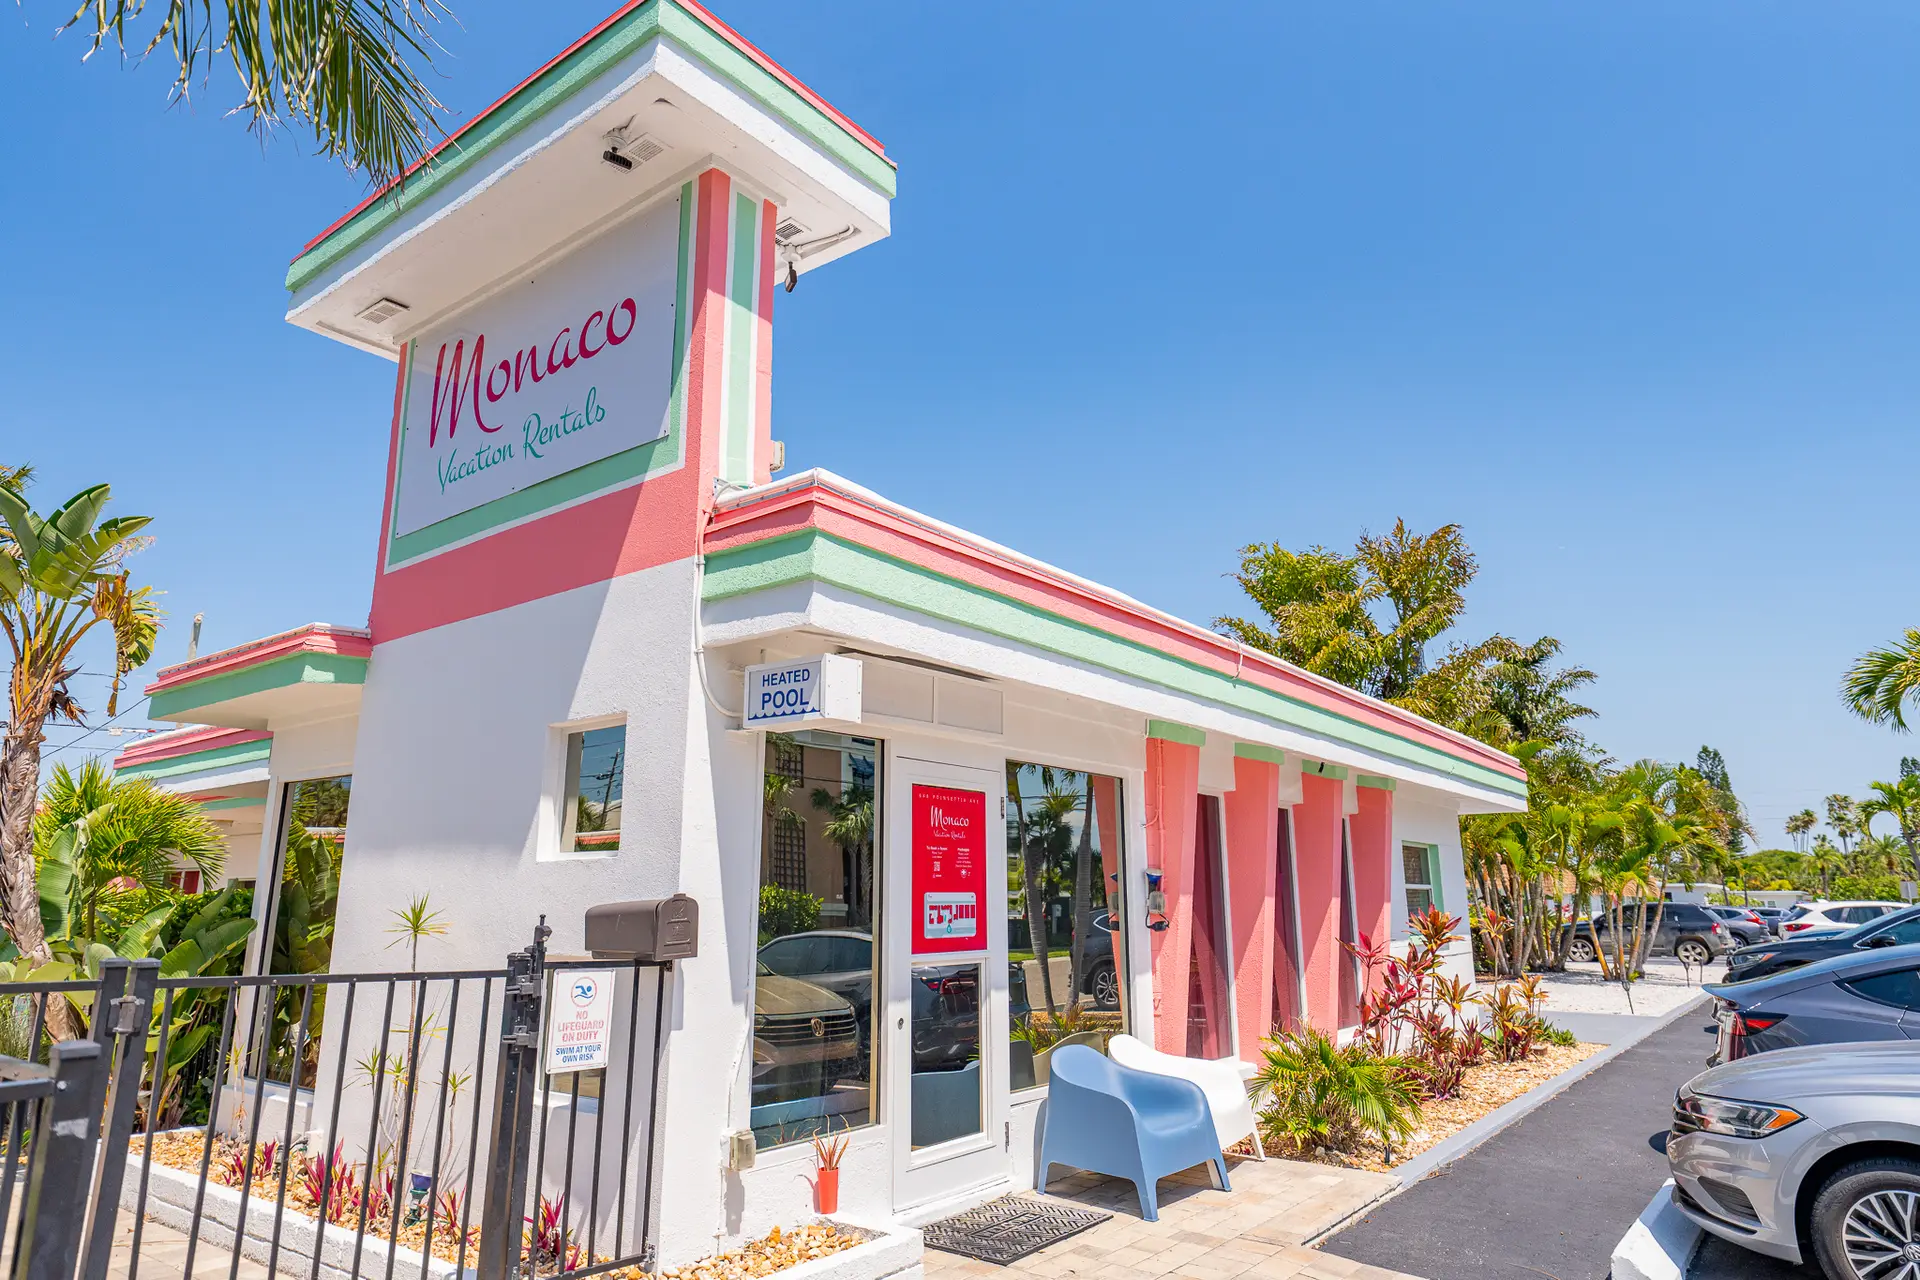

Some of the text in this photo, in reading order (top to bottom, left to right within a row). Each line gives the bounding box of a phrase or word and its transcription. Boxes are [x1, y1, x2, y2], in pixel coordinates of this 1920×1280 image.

[430, 298, 637, 449] Monaco
[438, 386, 606, 495] Vacation Rentals
[762, 668, 810, 687] HEATED
[761, 688, 809, 710] POOL
[930, 805, 969, 831] Monaco
[575, 1010, 589, 1020] NO
[557, 1020, 605, 1032] LIFEGUARD
[562, 1030, 599, 1042] ON DUTY
[555, 1044, 602, 1056] SWIM AT YOUR
[562, 1052, 594, 1063] OWN RISK
